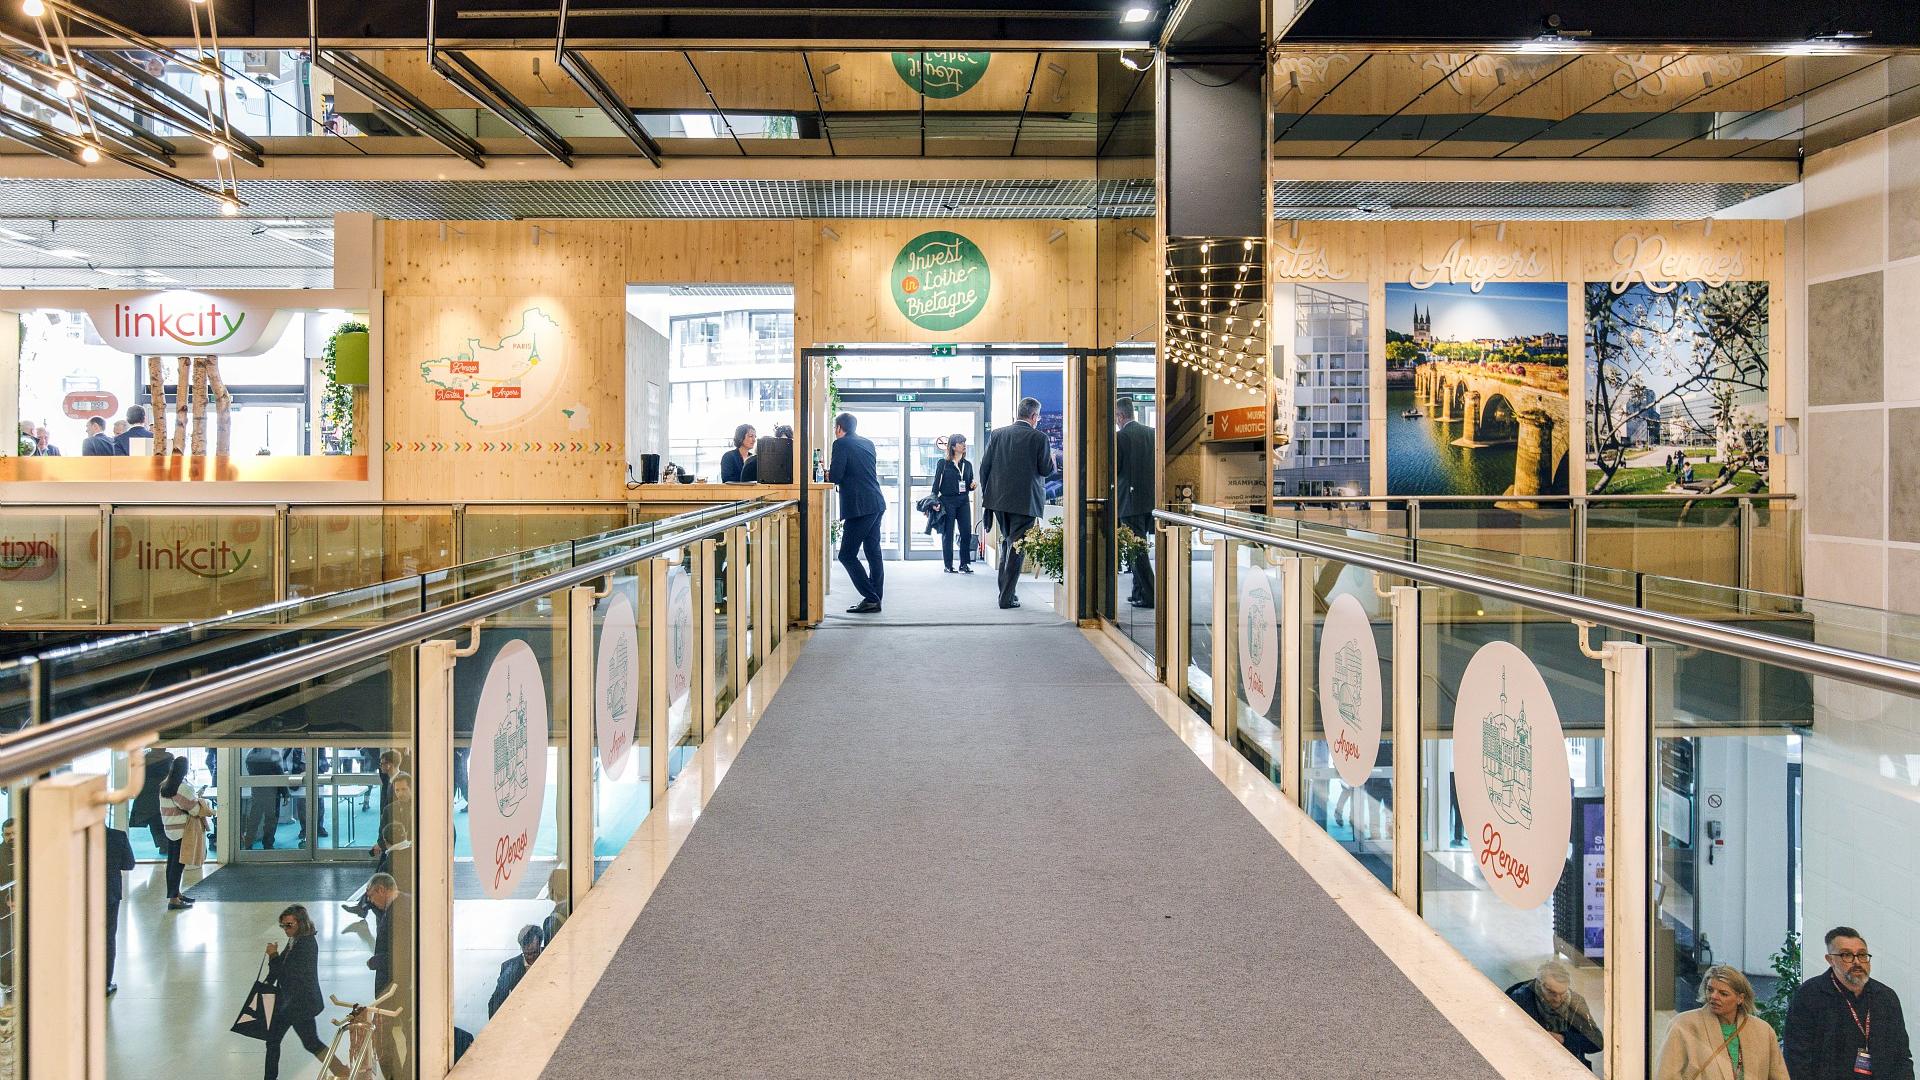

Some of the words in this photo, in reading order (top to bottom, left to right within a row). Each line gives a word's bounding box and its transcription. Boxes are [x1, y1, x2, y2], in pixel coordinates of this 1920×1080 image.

[908, 238, 963, 273] Invest
[1409, 236, 1545, 294] Angers
[1610, 232, 1744, 295] Rennes
[115, 303, 246, 347] linkcity
[906, 289, 978, 321] Bretagne
[138, 540, 251, 578] linkcity
[1334, 729, 1361, 761] Angers
[495, 828, 527, 890] Rennes
[1481, 823, 1530, 888] Rennes
